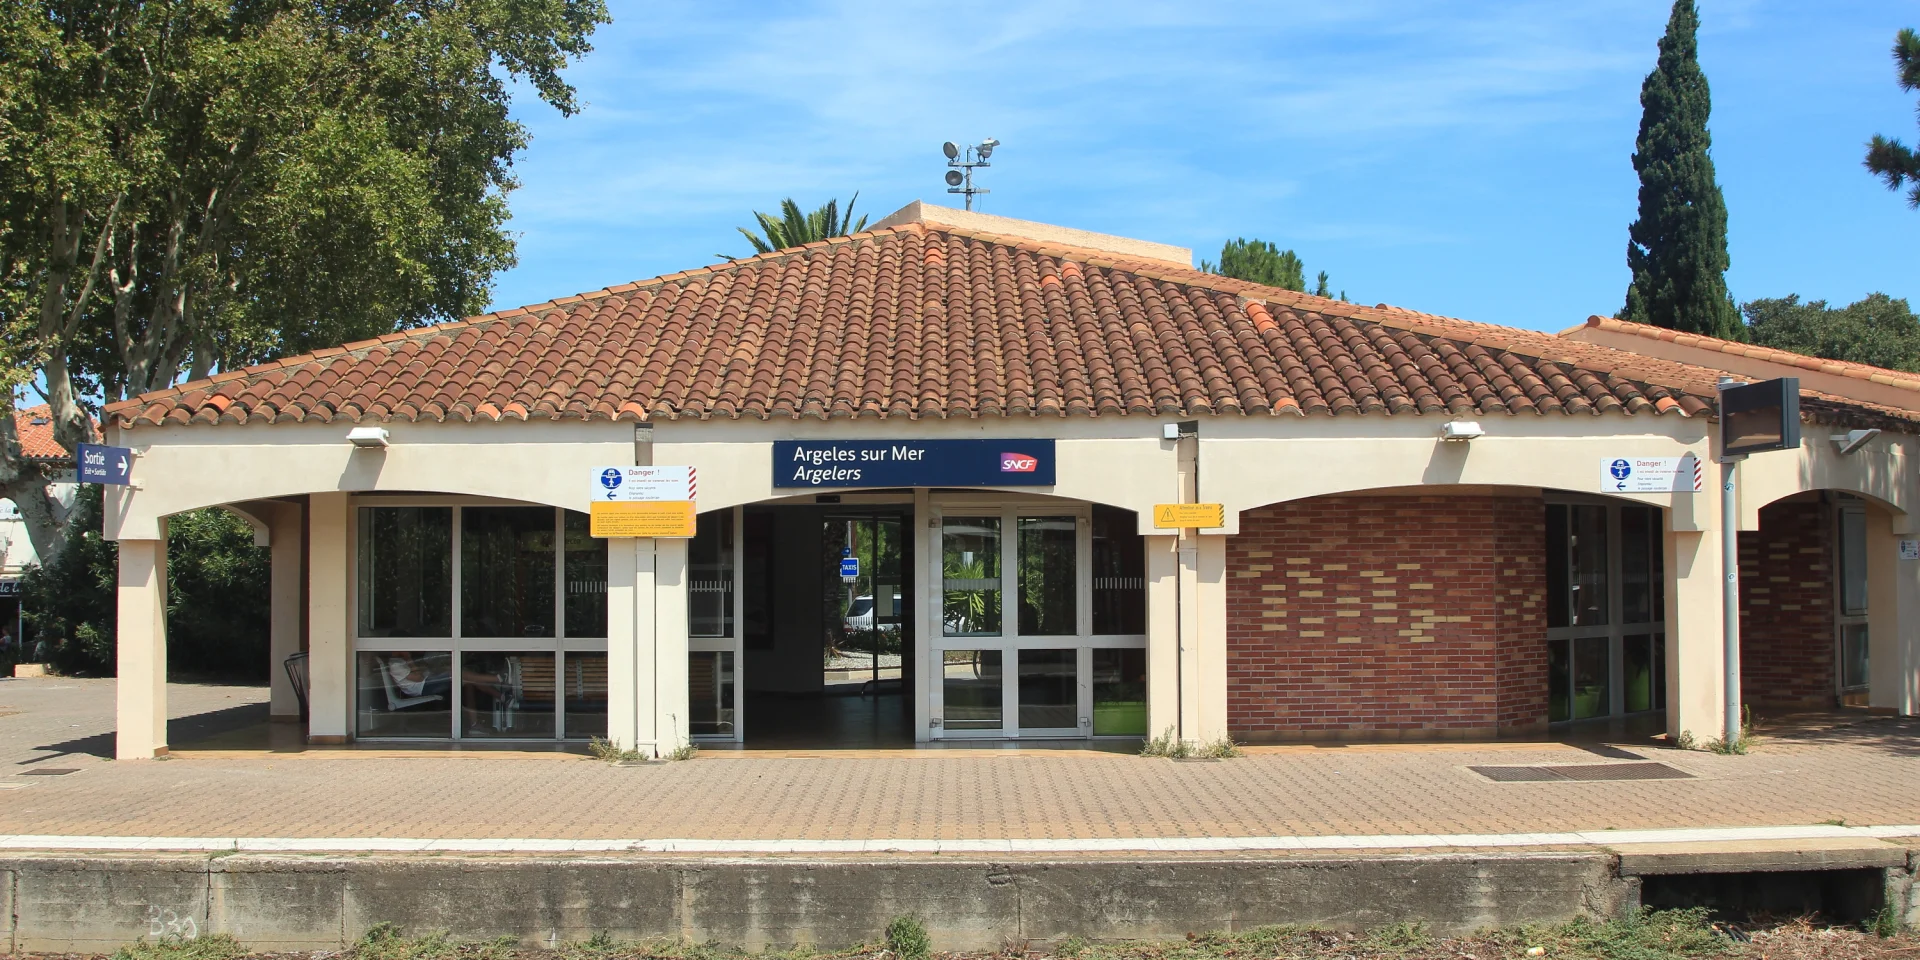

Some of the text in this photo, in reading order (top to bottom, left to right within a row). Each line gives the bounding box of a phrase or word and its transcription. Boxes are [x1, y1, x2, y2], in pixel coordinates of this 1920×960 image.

[84, 449, 105, 466] Sortie
[793, 446, 925, 465] Argeles sur Mer
[1002, 459, 1035, 470] SNCF
[1637, 460, 1662, 468] Danger
[628, 469, 655, 477] Danger
[793, 465, 862, 484] Argelers
